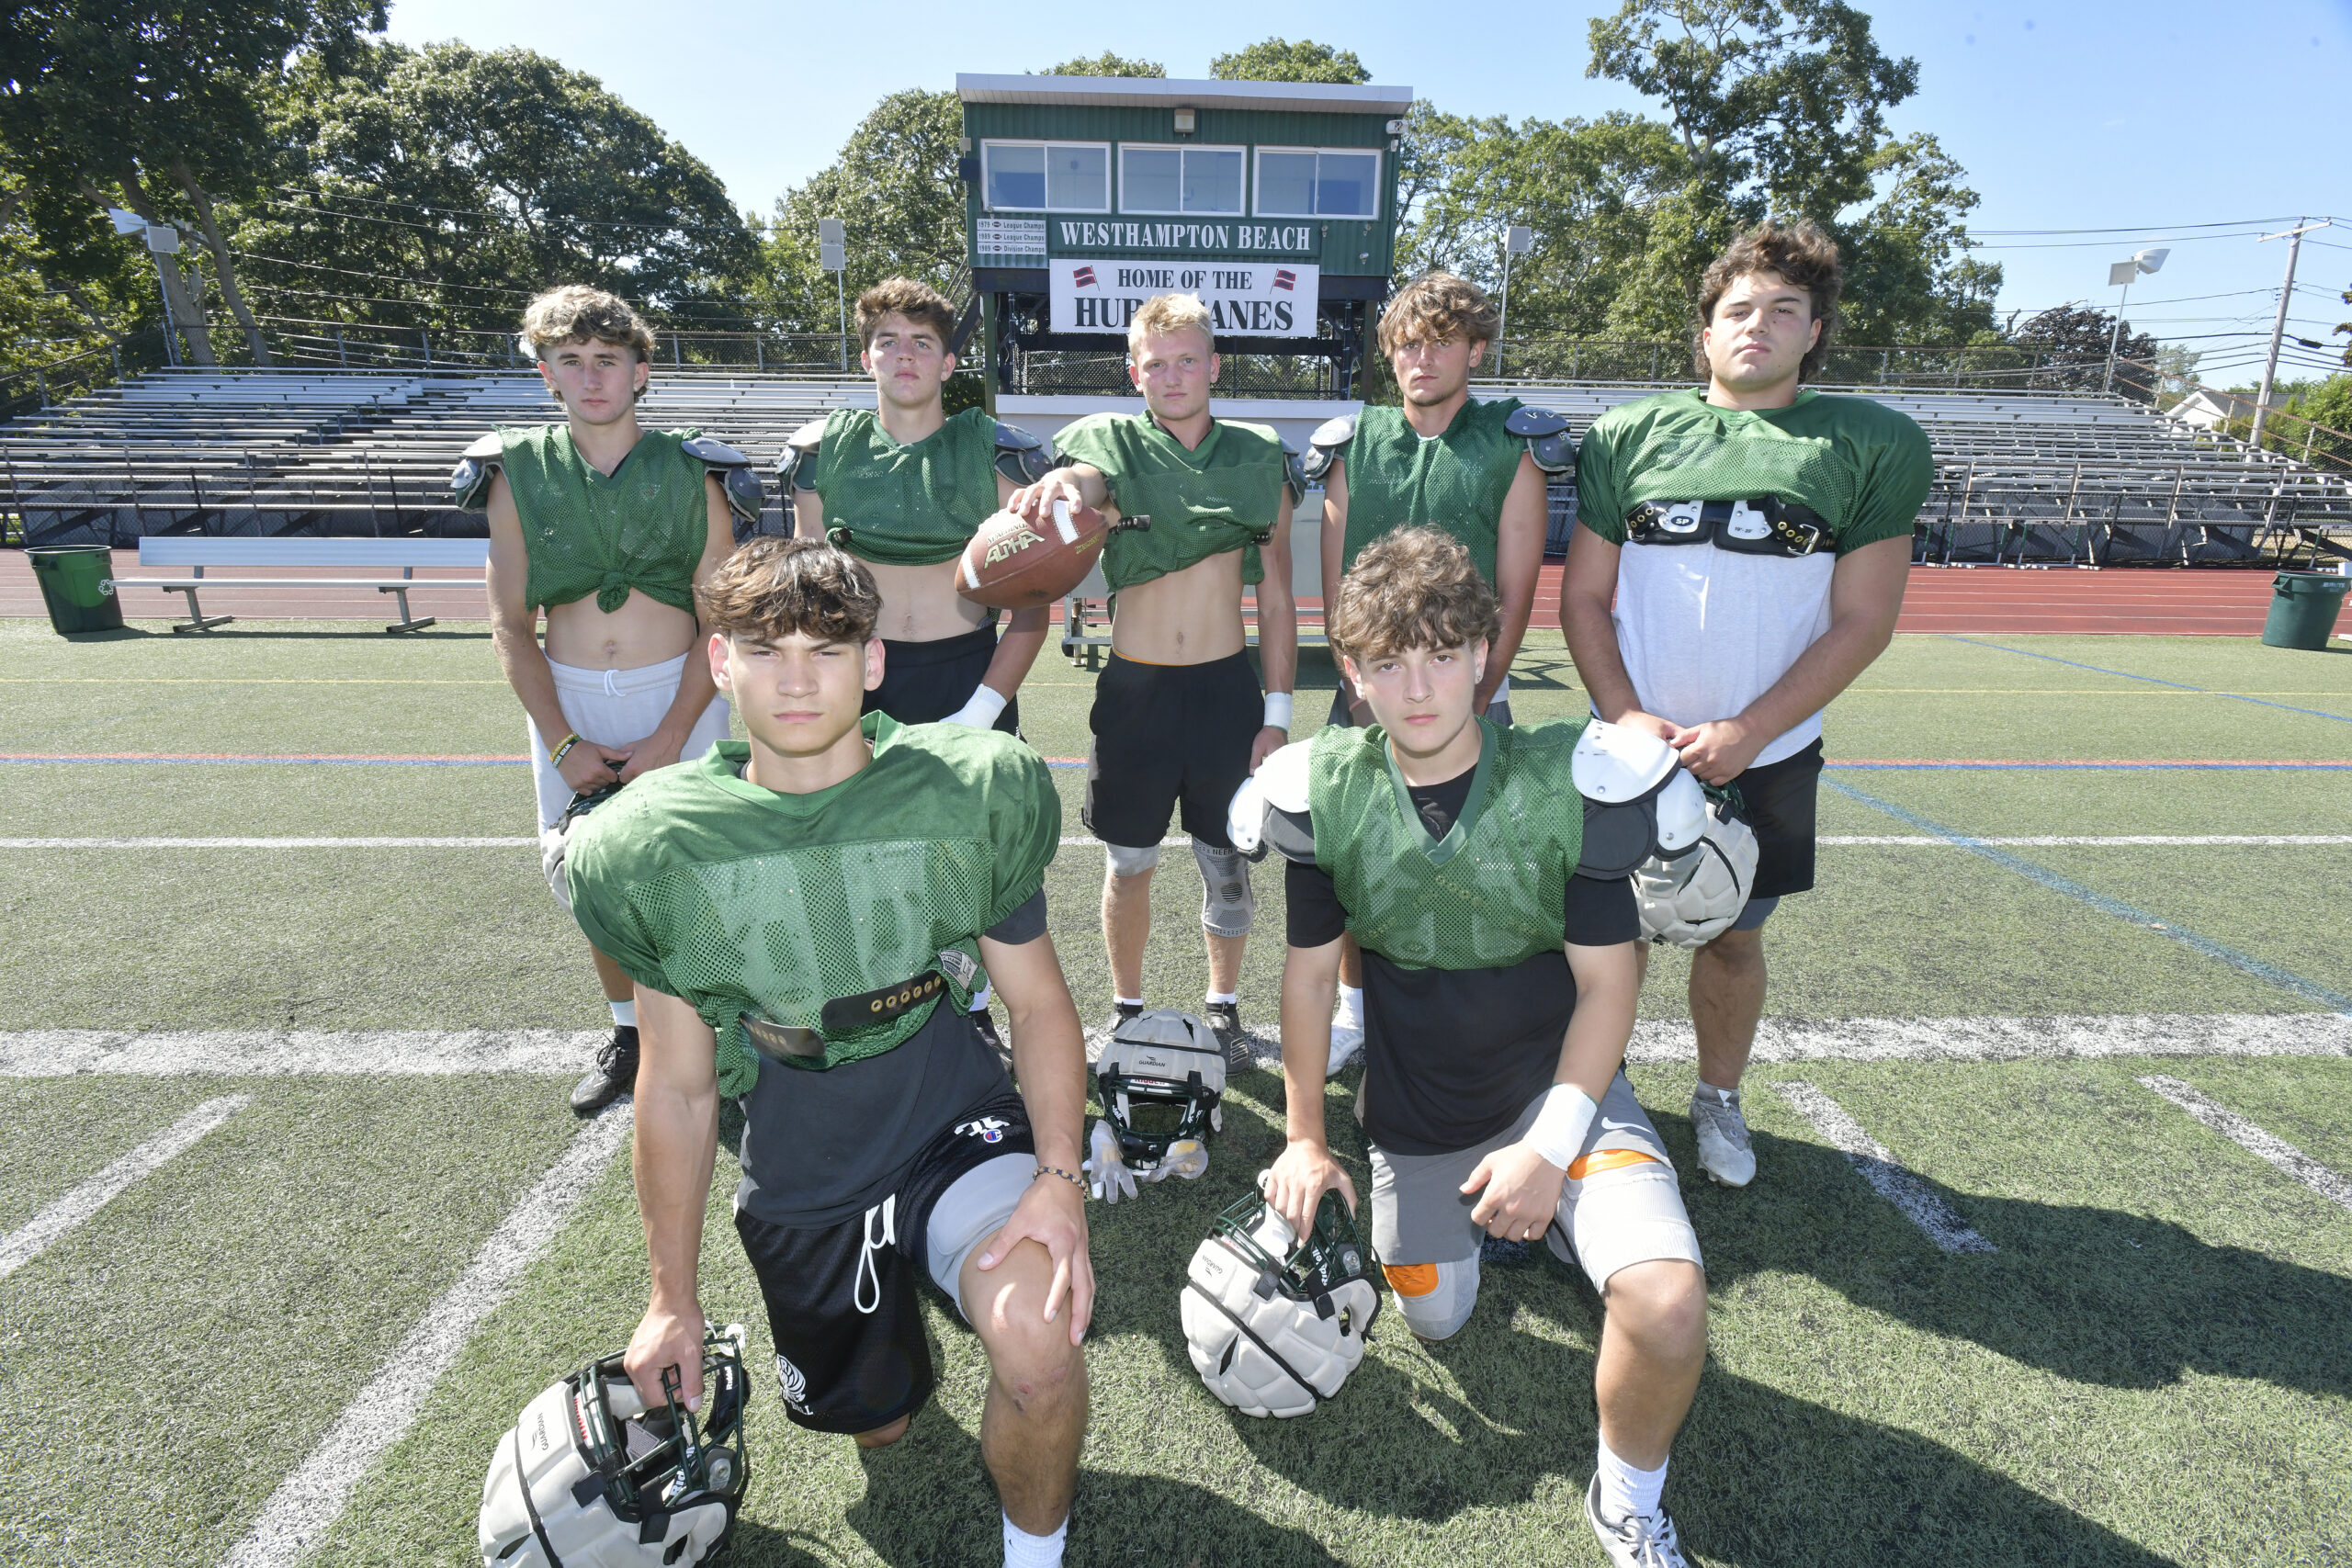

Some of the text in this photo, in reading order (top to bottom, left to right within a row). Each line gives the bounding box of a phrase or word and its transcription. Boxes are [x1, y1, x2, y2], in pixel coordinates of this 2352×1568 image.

[1003, 222, 1022, 231] League
[1023, 222, 1045, 231] Champs
[1003, 233, 1023, 242] League
[1023, 233, 1045, 242] Champs
[1059, 221, 1311, 251] WESTHAMPTON BEACH
[1117, 268, 1252, 290] HOME OF THE
[984, 530, 1046, 570] ALPHA
[1202, 1255, 1223, 1275] GUARDIAN
[537, 1412, 549, 1451] GUARDIAN
